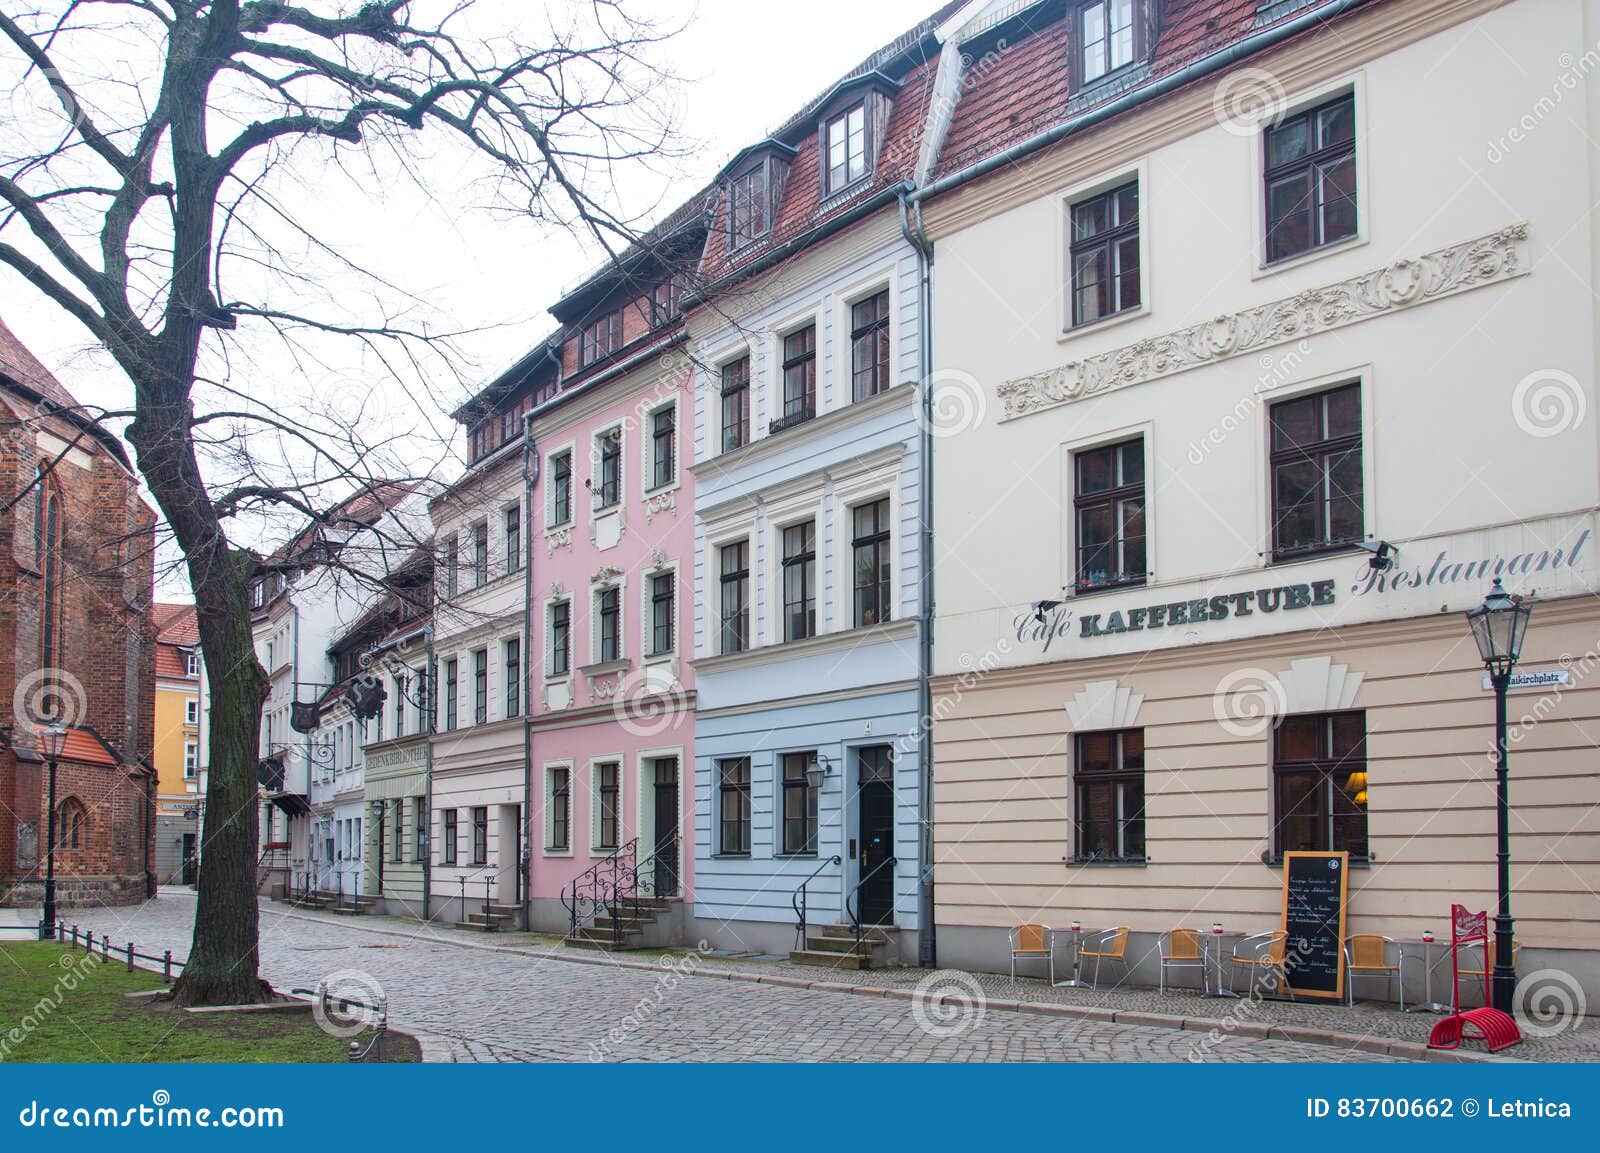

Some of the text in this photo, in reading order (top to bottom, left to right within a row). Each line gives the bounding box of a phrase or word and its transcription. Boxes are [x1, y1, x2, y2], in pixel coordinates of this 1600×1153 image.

[1013, 528, 1592, 653] Café KAFFEESTUBE Restaurant
[1509, 672, 1560, 685] aikirchplatz
